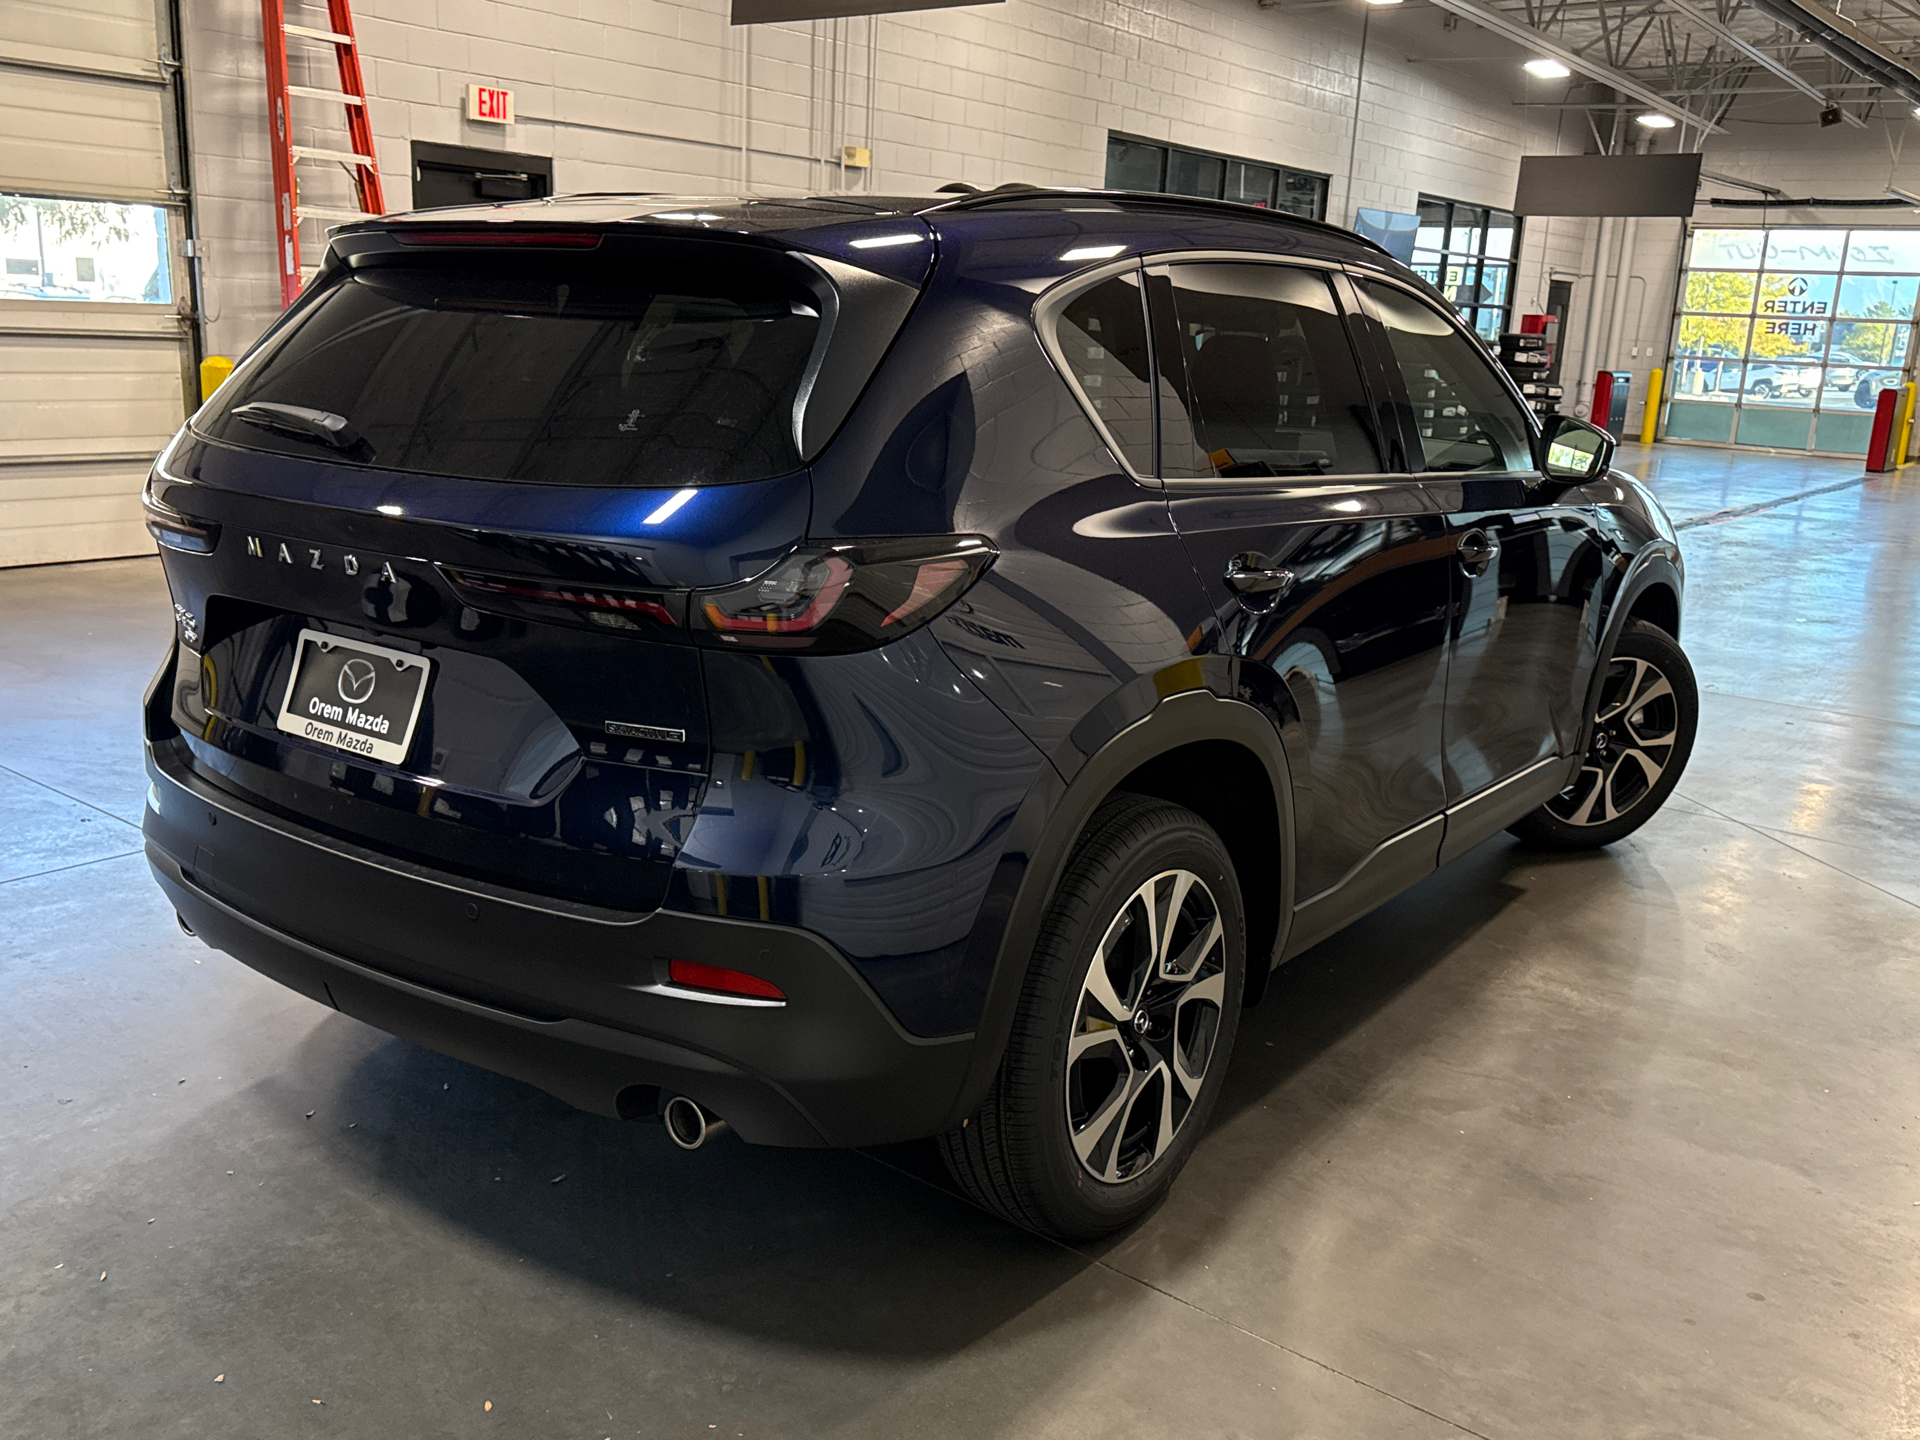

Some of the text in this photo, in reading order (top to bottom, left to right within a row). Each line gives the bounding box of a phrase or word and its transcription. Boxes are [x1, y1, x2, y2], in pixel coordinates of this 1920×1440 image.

[478, 87, 509, 120] EXIT
[247, 535, 397, 583] MAZDA
[309, 696, 390, 734] Orem Mazda
[304, 721, 374, 754] Orem Mazda
